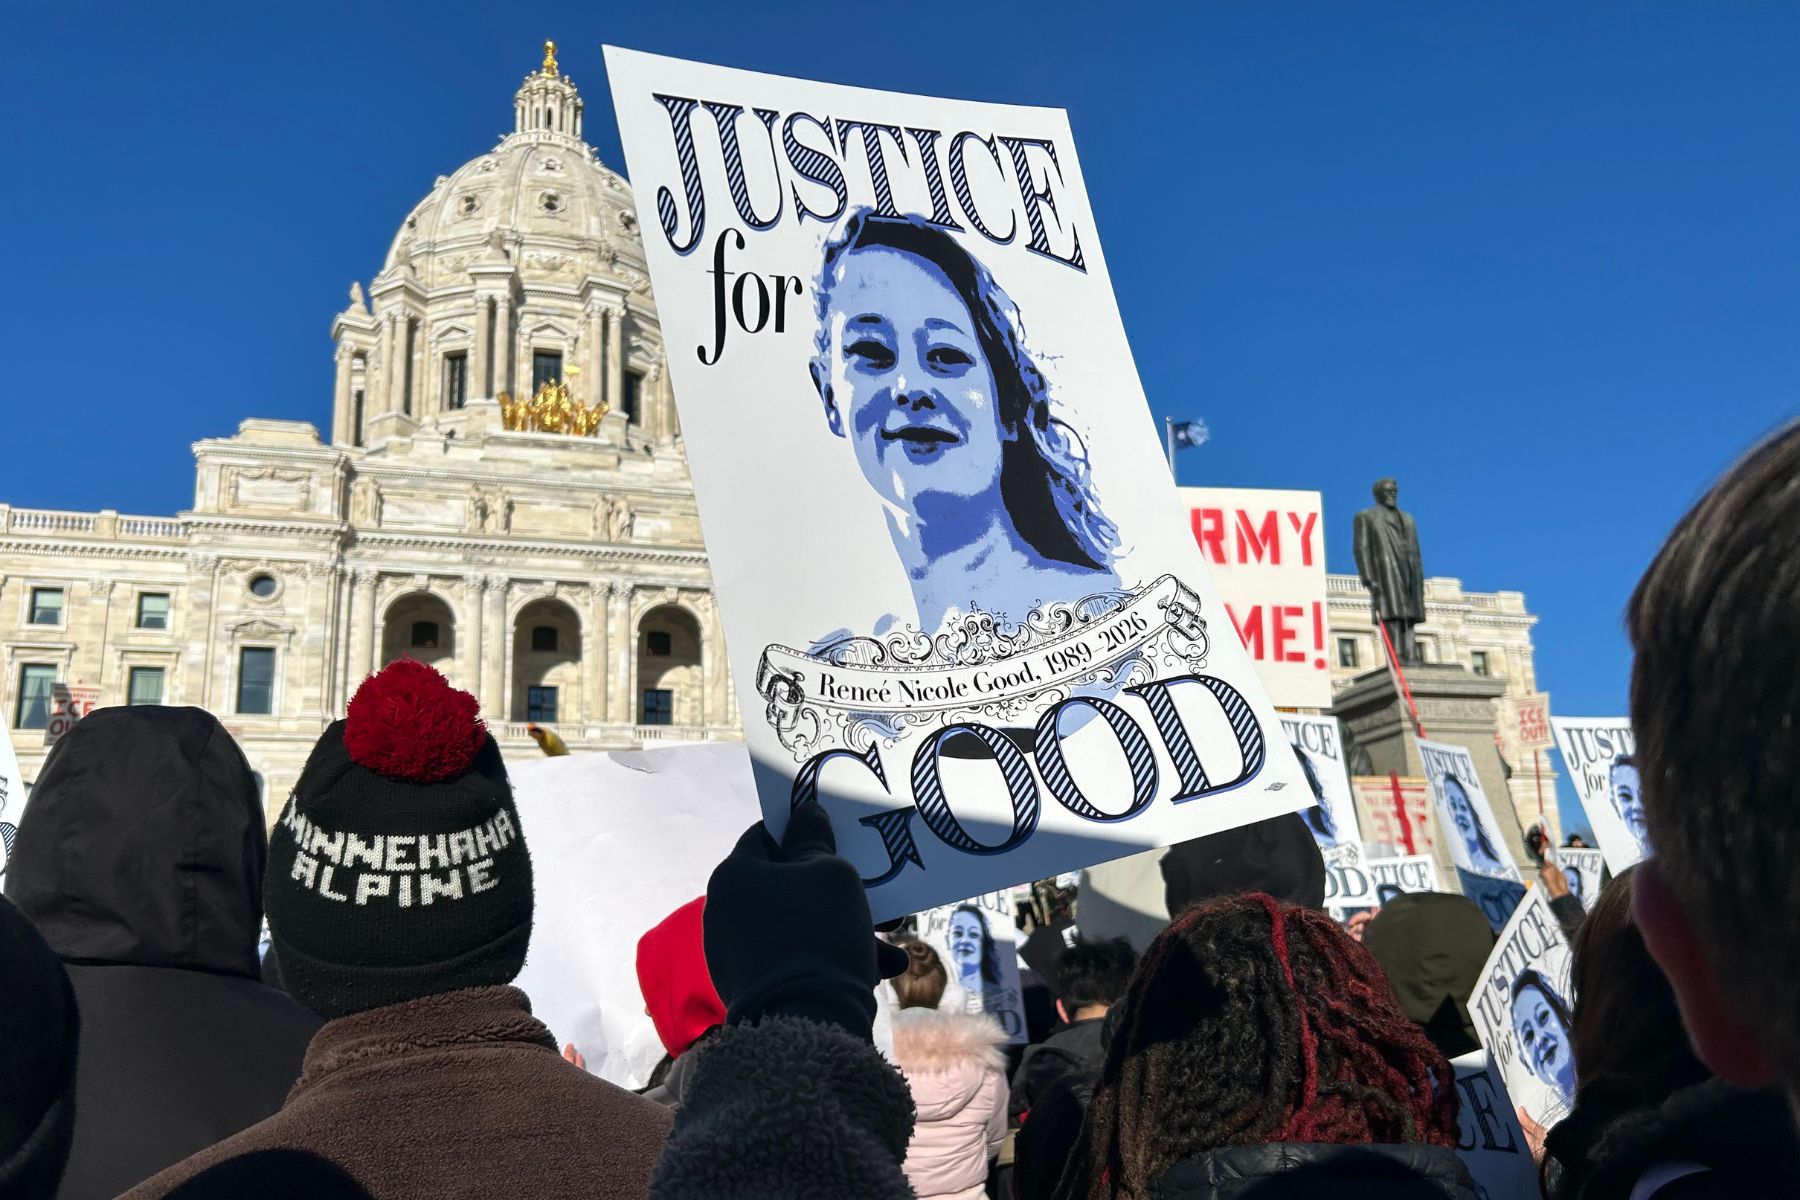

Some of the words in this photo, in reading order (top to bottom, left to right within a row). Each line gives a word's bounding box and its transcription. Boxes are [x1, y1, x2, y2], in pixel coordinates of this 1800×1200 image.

[652, 93, 1088, 274] JUSTICE
[697, 228, 803, 366] for
[818, 671, 891, 702] Reneé
[898, 678, 969, 703] Nicole
[973, 671, 1042, 694] Good,
[790, 674, 1266, 888] GOOD
[1583, 761, 1606, 800] for
[291, 850, 500, 908] ALPINE
[1476, 898, 1559, 1053] JUSTICE
